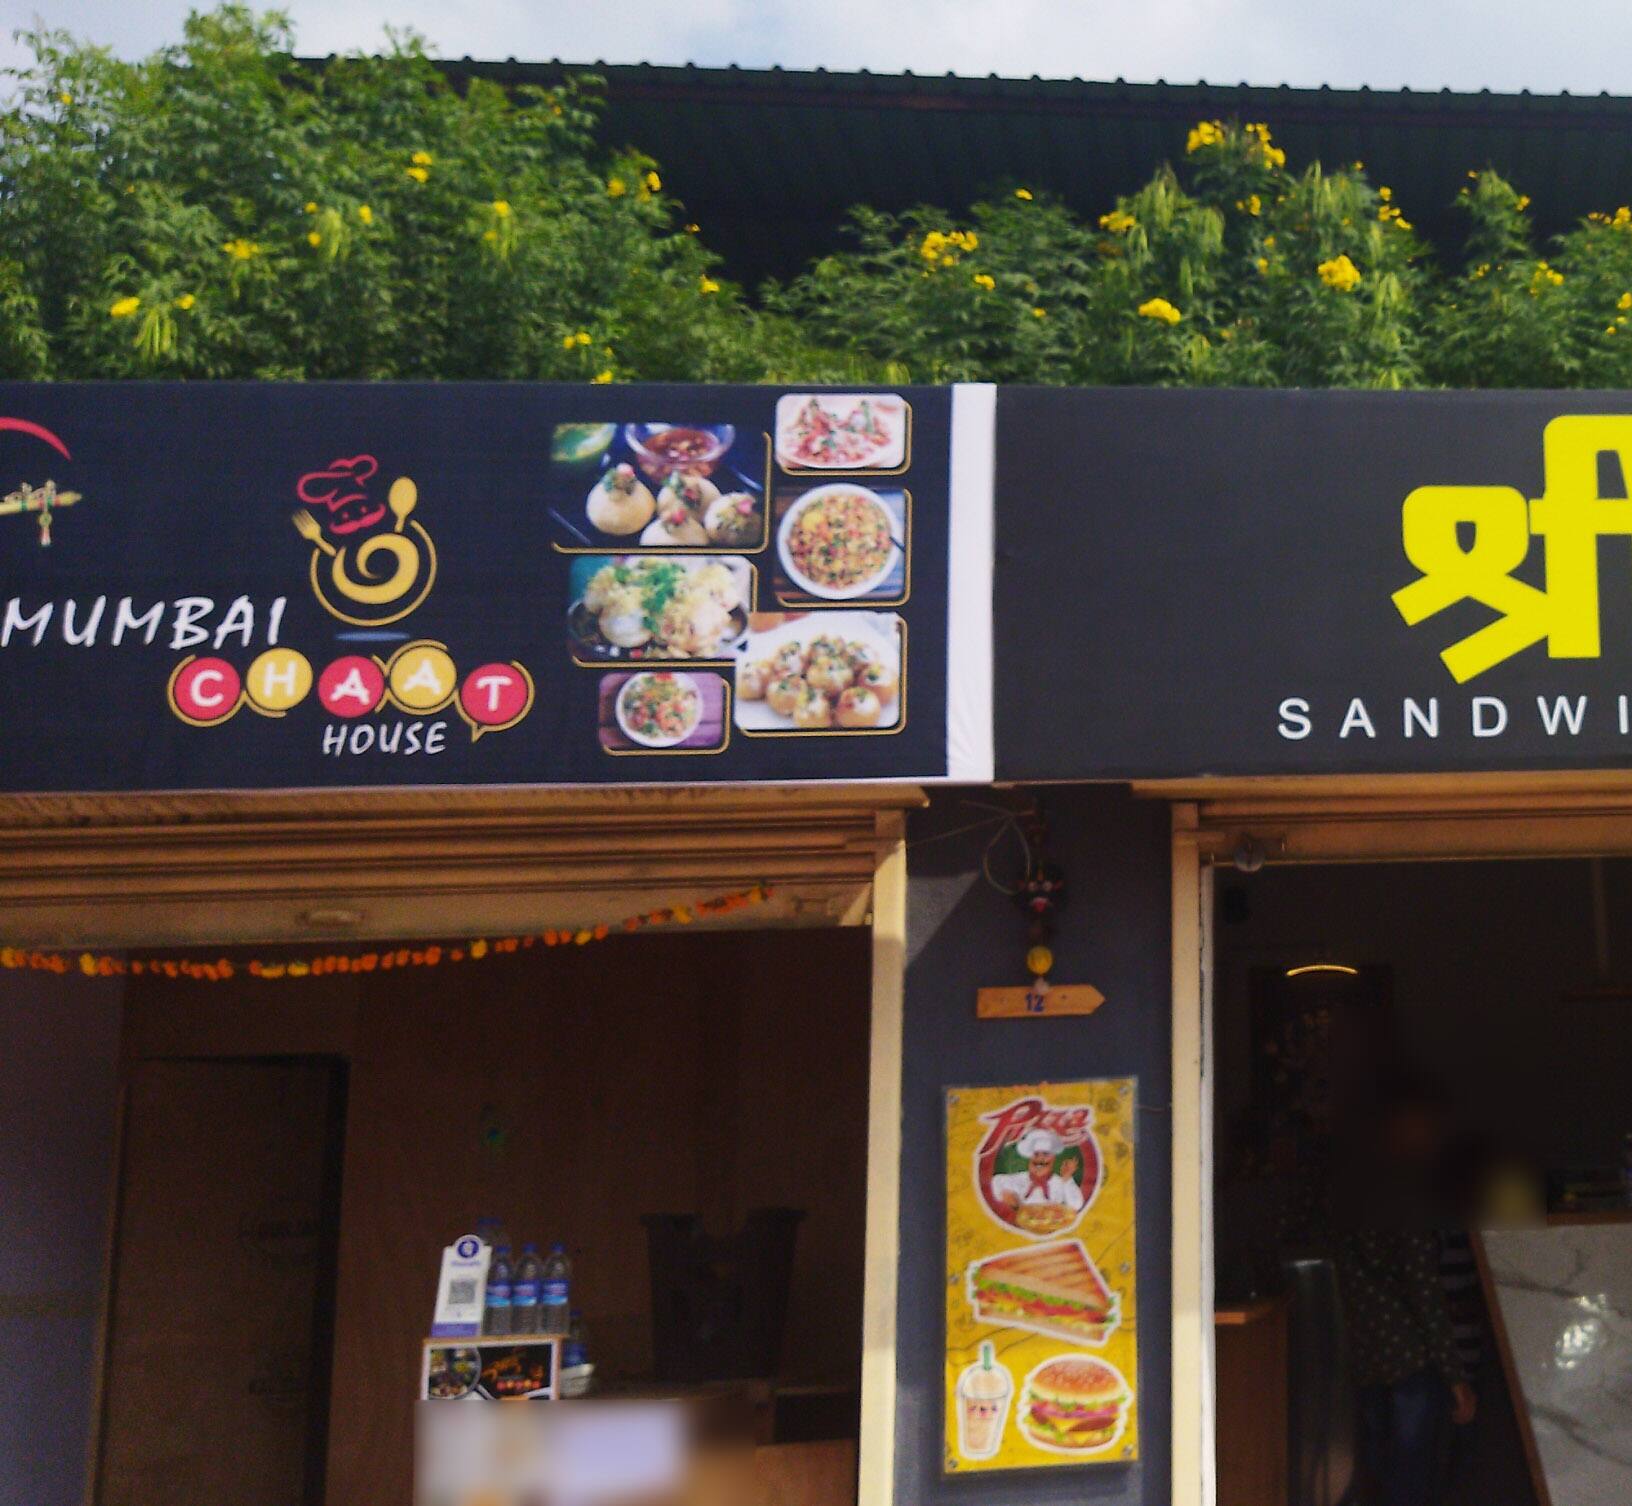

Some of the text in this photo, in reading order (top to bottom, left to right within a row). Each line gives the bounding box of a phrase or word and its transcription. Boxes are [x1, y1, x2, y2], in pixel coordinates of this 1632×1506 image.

[1, 594, 286, 649] MUMBAI
[187, 658, 517, 715] CHAAT
[323, 721, 448, 756] HOUSE
